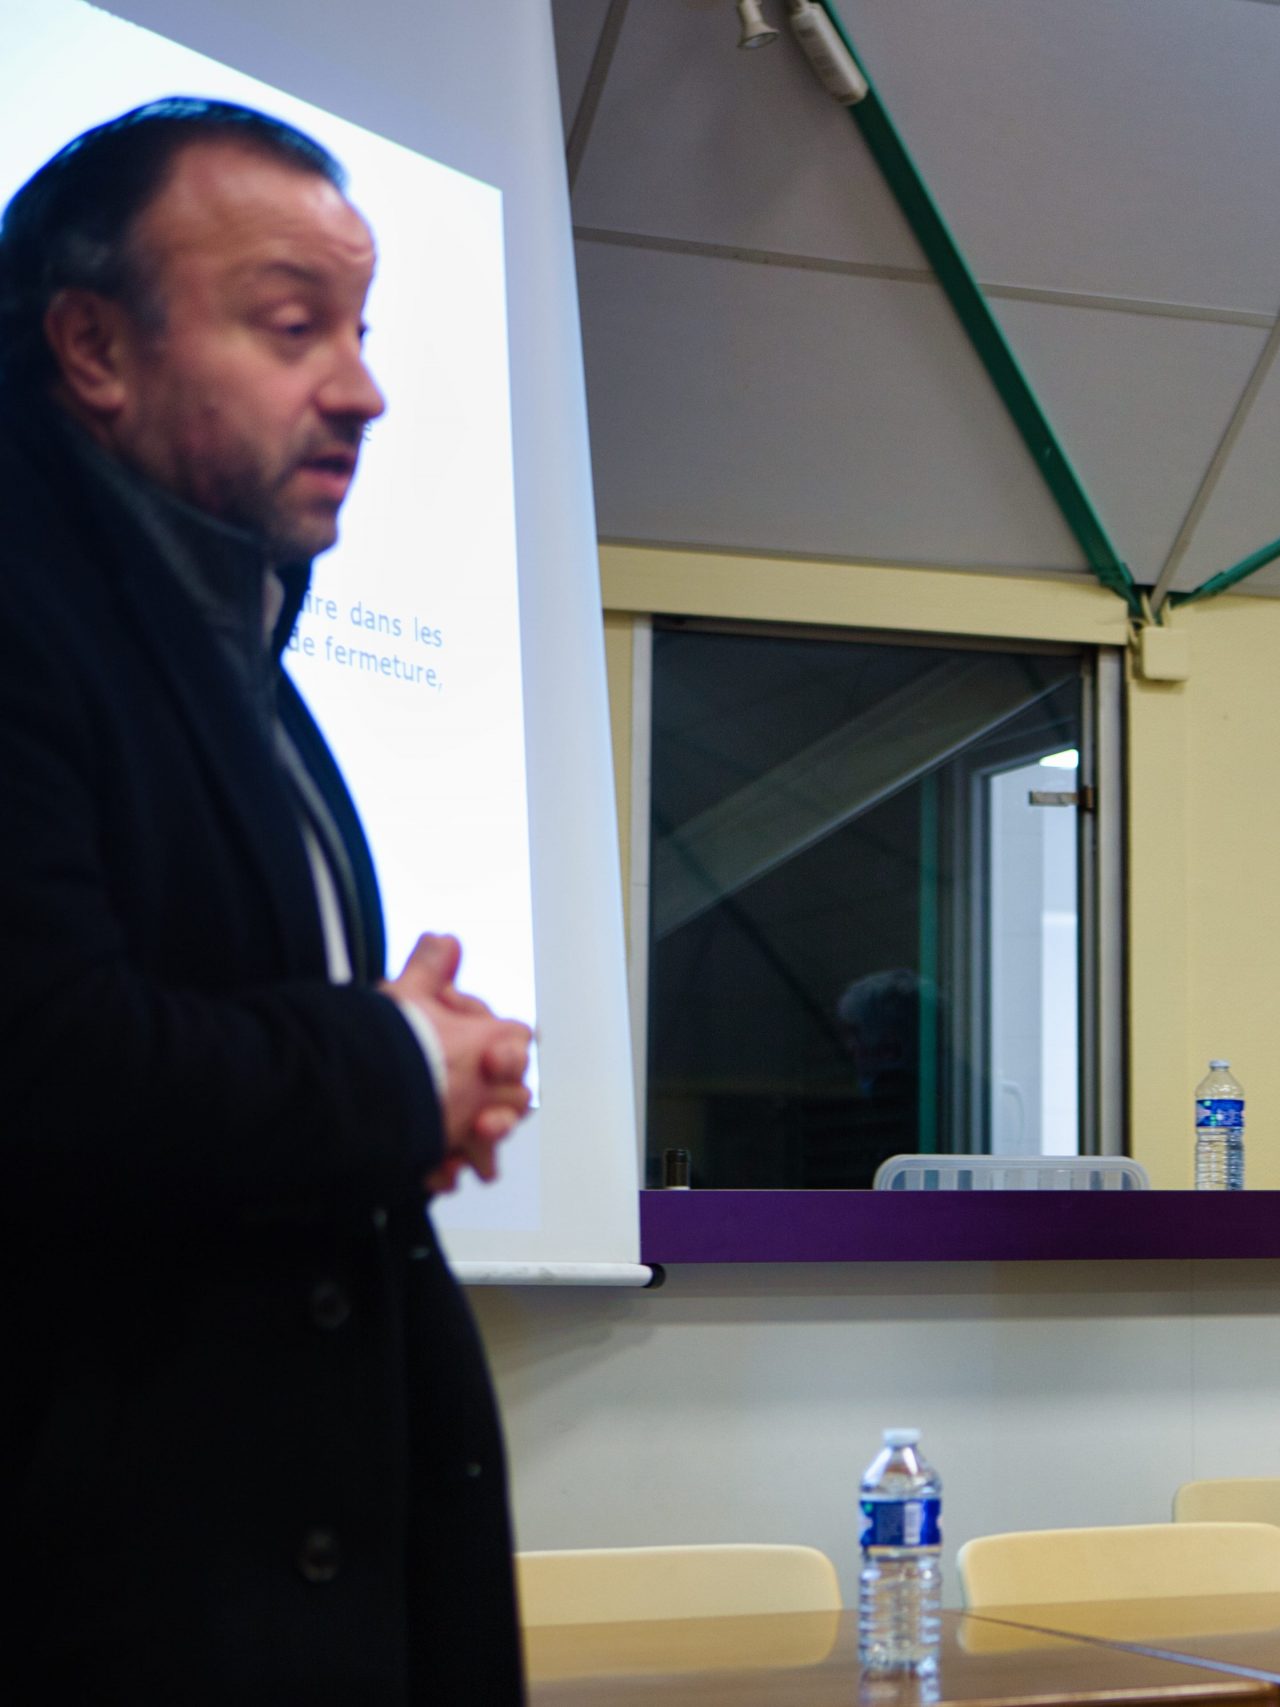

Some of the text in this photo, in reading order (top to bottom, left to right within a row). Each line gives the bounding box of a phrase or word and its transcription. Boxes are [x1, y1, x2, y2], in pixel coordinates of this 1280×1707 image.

[302, 587, 443, 648] ire dans les
[325, 635, 443, 694] fermeture,
